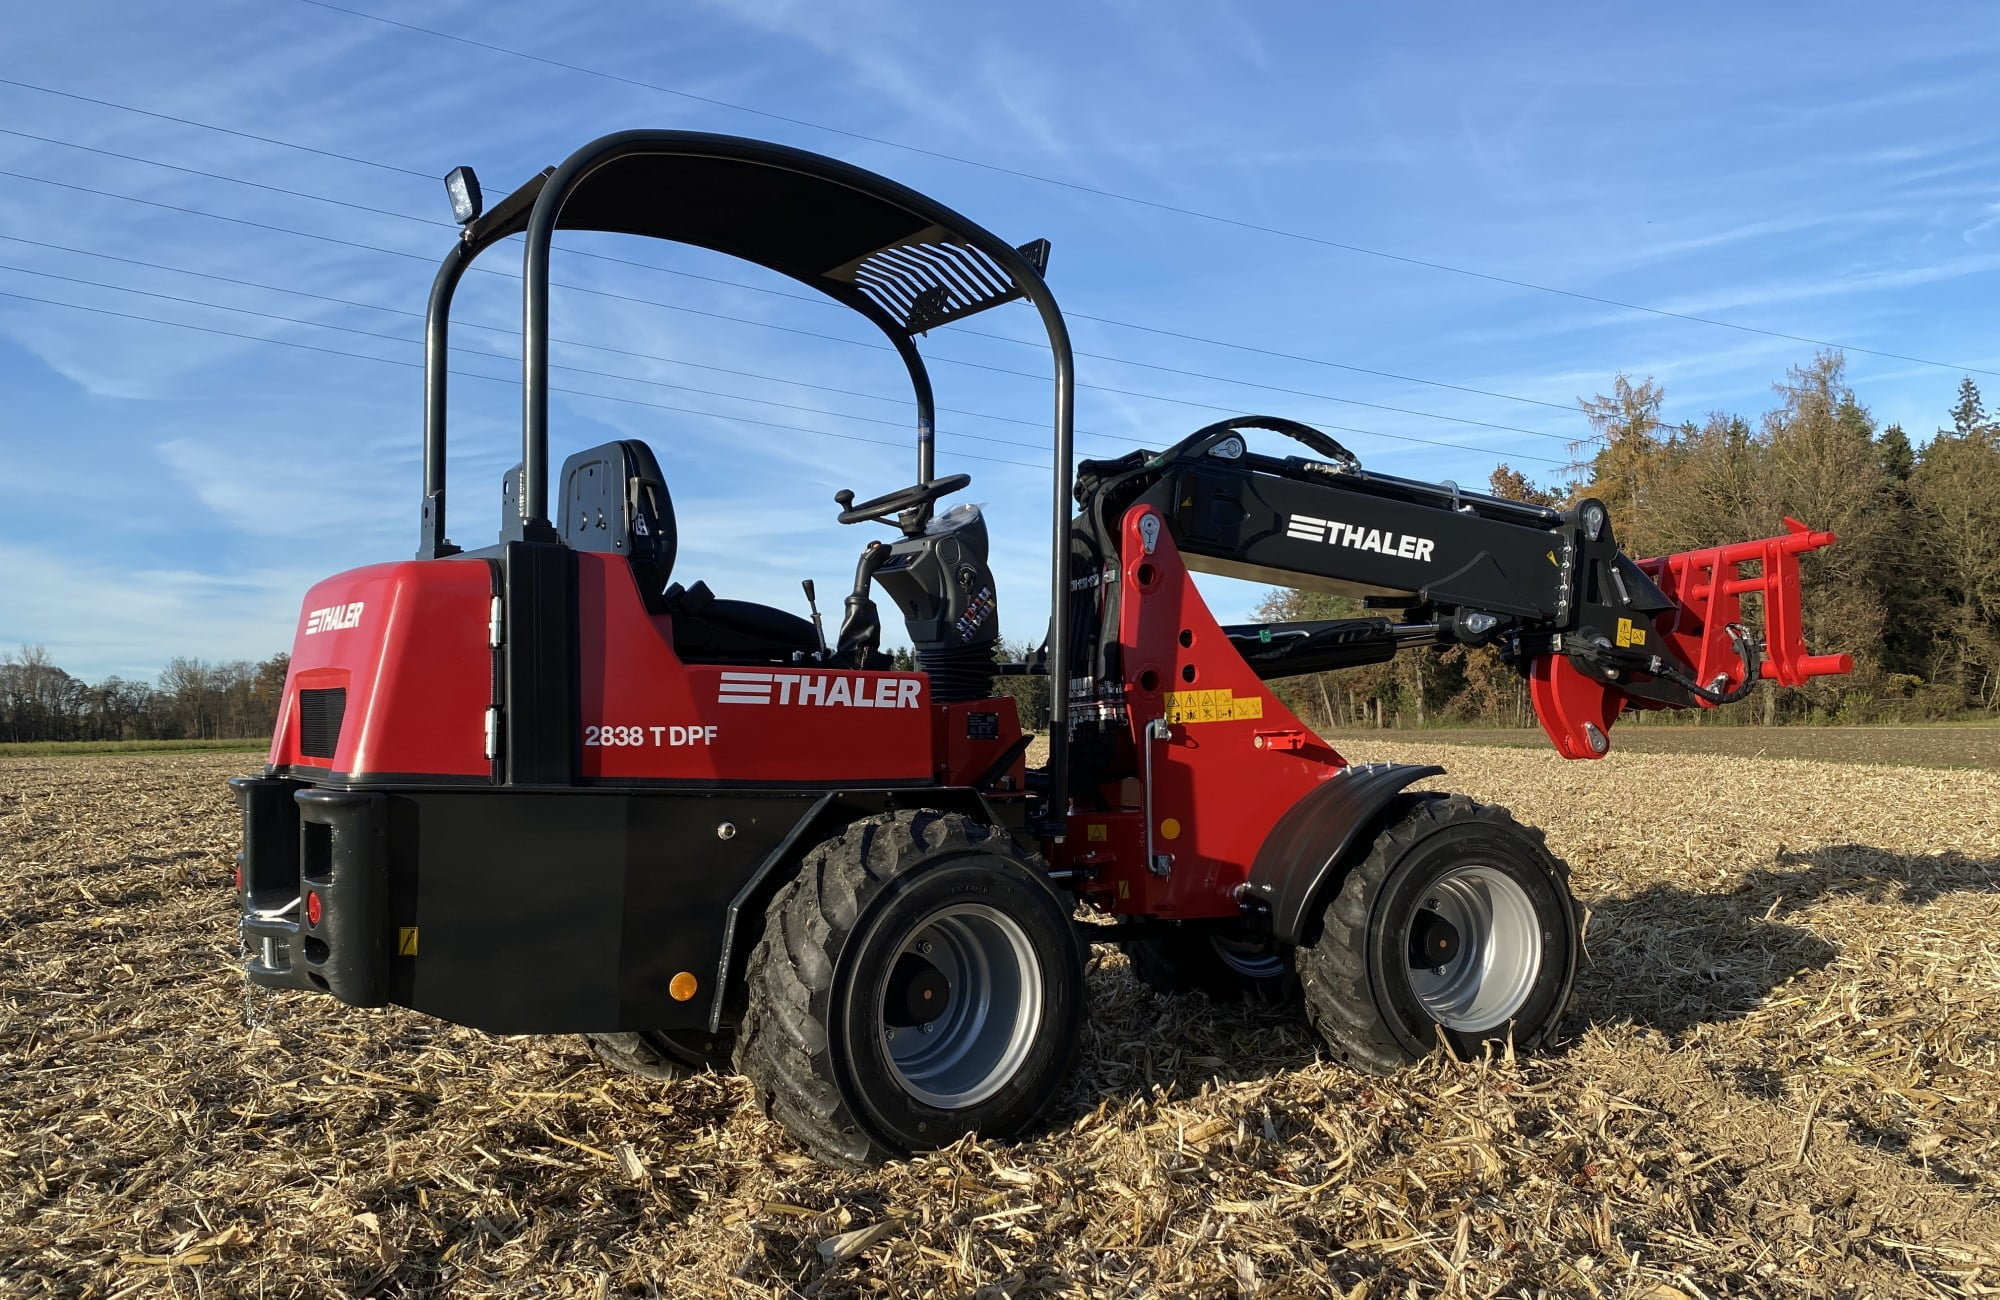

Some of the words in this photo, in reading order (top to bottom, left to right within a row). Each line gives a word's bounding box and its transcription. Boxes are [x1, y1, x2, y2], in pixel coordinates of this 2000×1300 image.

[1326, 520, 1435, 562] THALER
[318, 602, 364, 632] THALER
[773, 674, 921, 708] THALER
[585, 725, 644, 746] 2838
